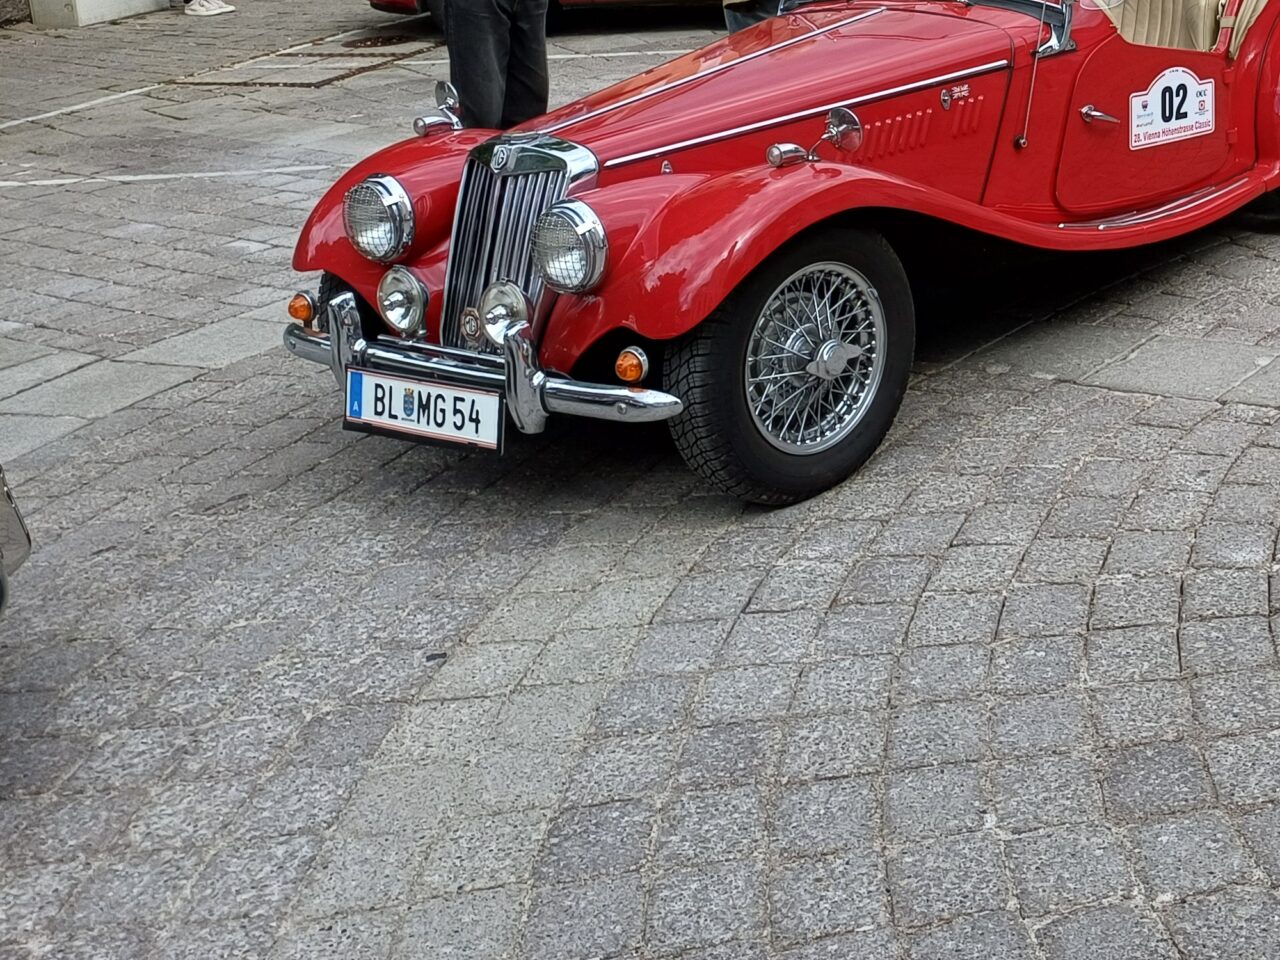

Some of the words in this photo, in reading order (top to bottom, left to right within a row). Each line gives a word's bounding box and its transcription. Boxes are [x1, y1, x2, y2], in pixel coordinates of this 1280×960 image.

[1161, 83, 1188, 123] 02
[1143, 130, 1160, 141] Vienna
[1195, 119, 1211, 129] Classic
[352, 400, 359, 412] A
[374, 383, 398, 420] BL
